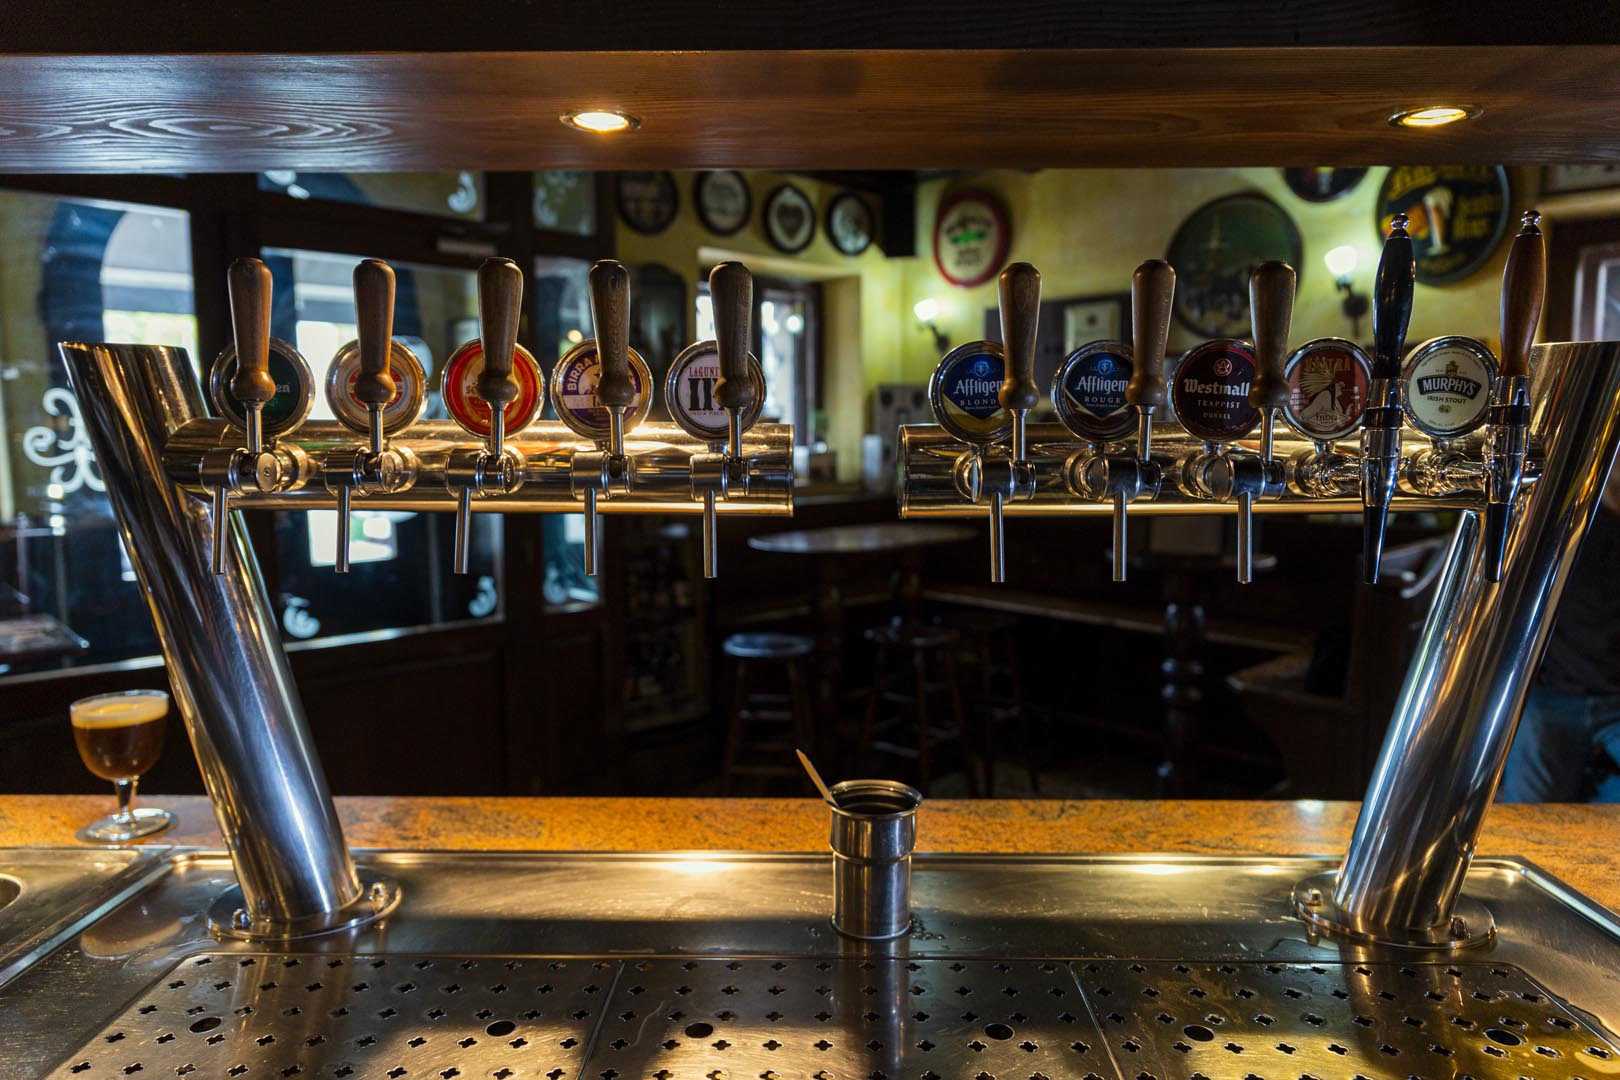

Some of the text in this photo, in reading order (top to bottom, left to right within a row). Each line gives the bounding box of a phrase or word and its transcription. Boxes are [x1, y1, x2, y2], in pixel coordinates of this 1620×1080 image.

[566, 356, 593, 391] BIRRA
[689, 366, 720, 377] LAGUNI
[1076, 376, 1129, 395] Affligem
[1183, 378, 1251, 397] Westmall
[1085, 396, 1121, 404] ROUGE
[1198, 400, 1241, 409] TRAPPIST
[1427, 395, 1467, 404] IRISH STOUT
